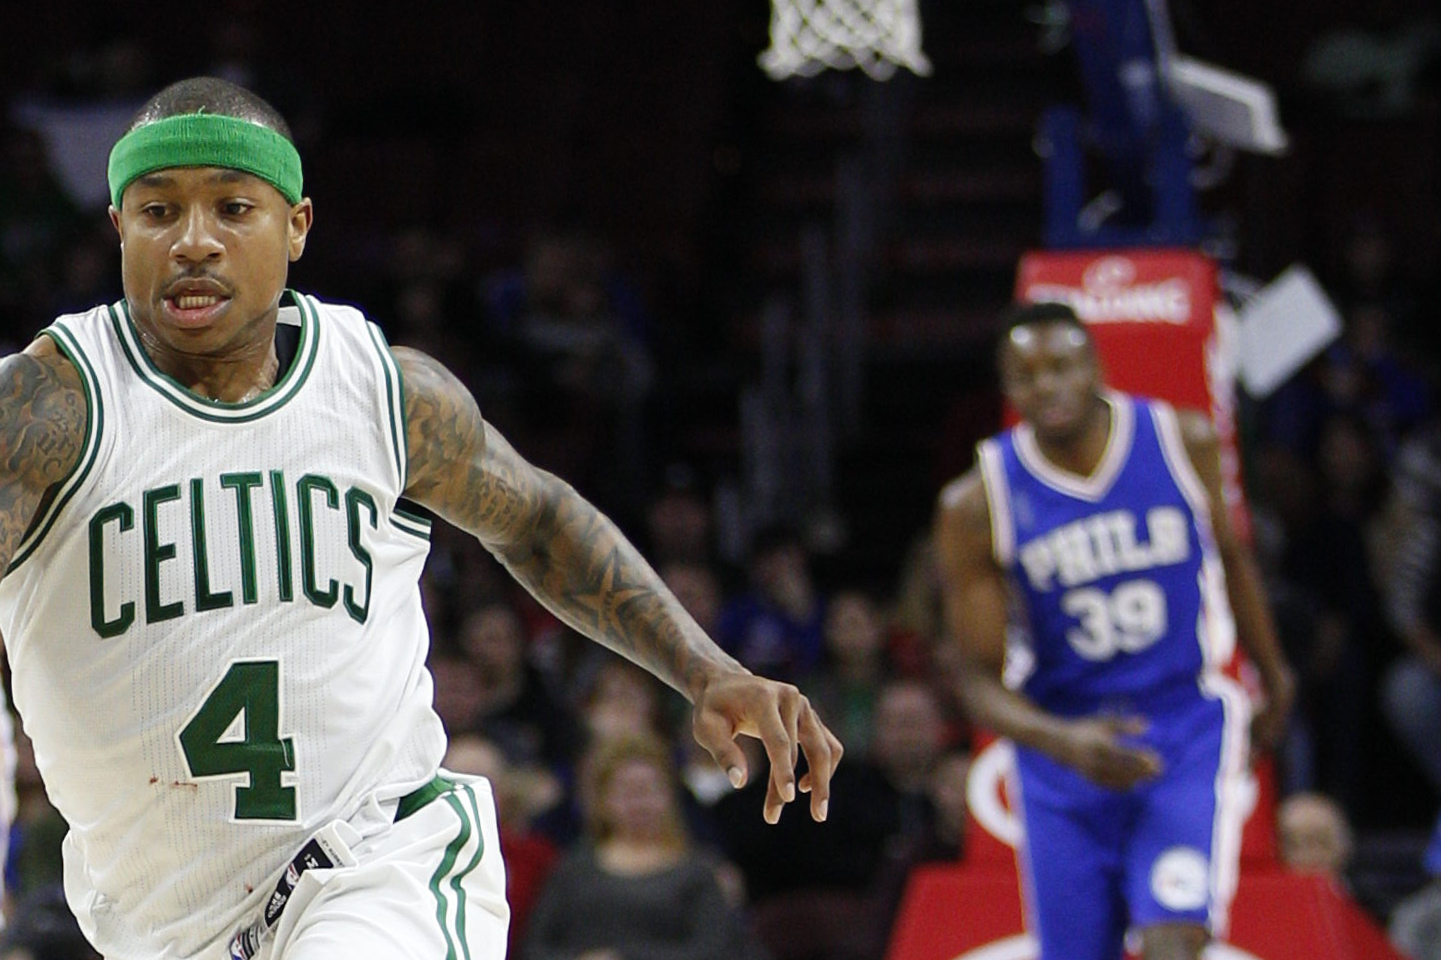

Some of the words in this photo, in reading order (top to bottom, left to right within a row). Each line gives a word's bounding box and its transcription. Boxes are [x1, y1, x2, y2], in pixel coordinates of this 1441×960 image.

[88, 469, 378, 639] CELTICS
[1018, 505, 1191, 593] PHILA
[1062, 577, 1169, 663] 39
[176, 657, 300, 824] 4
